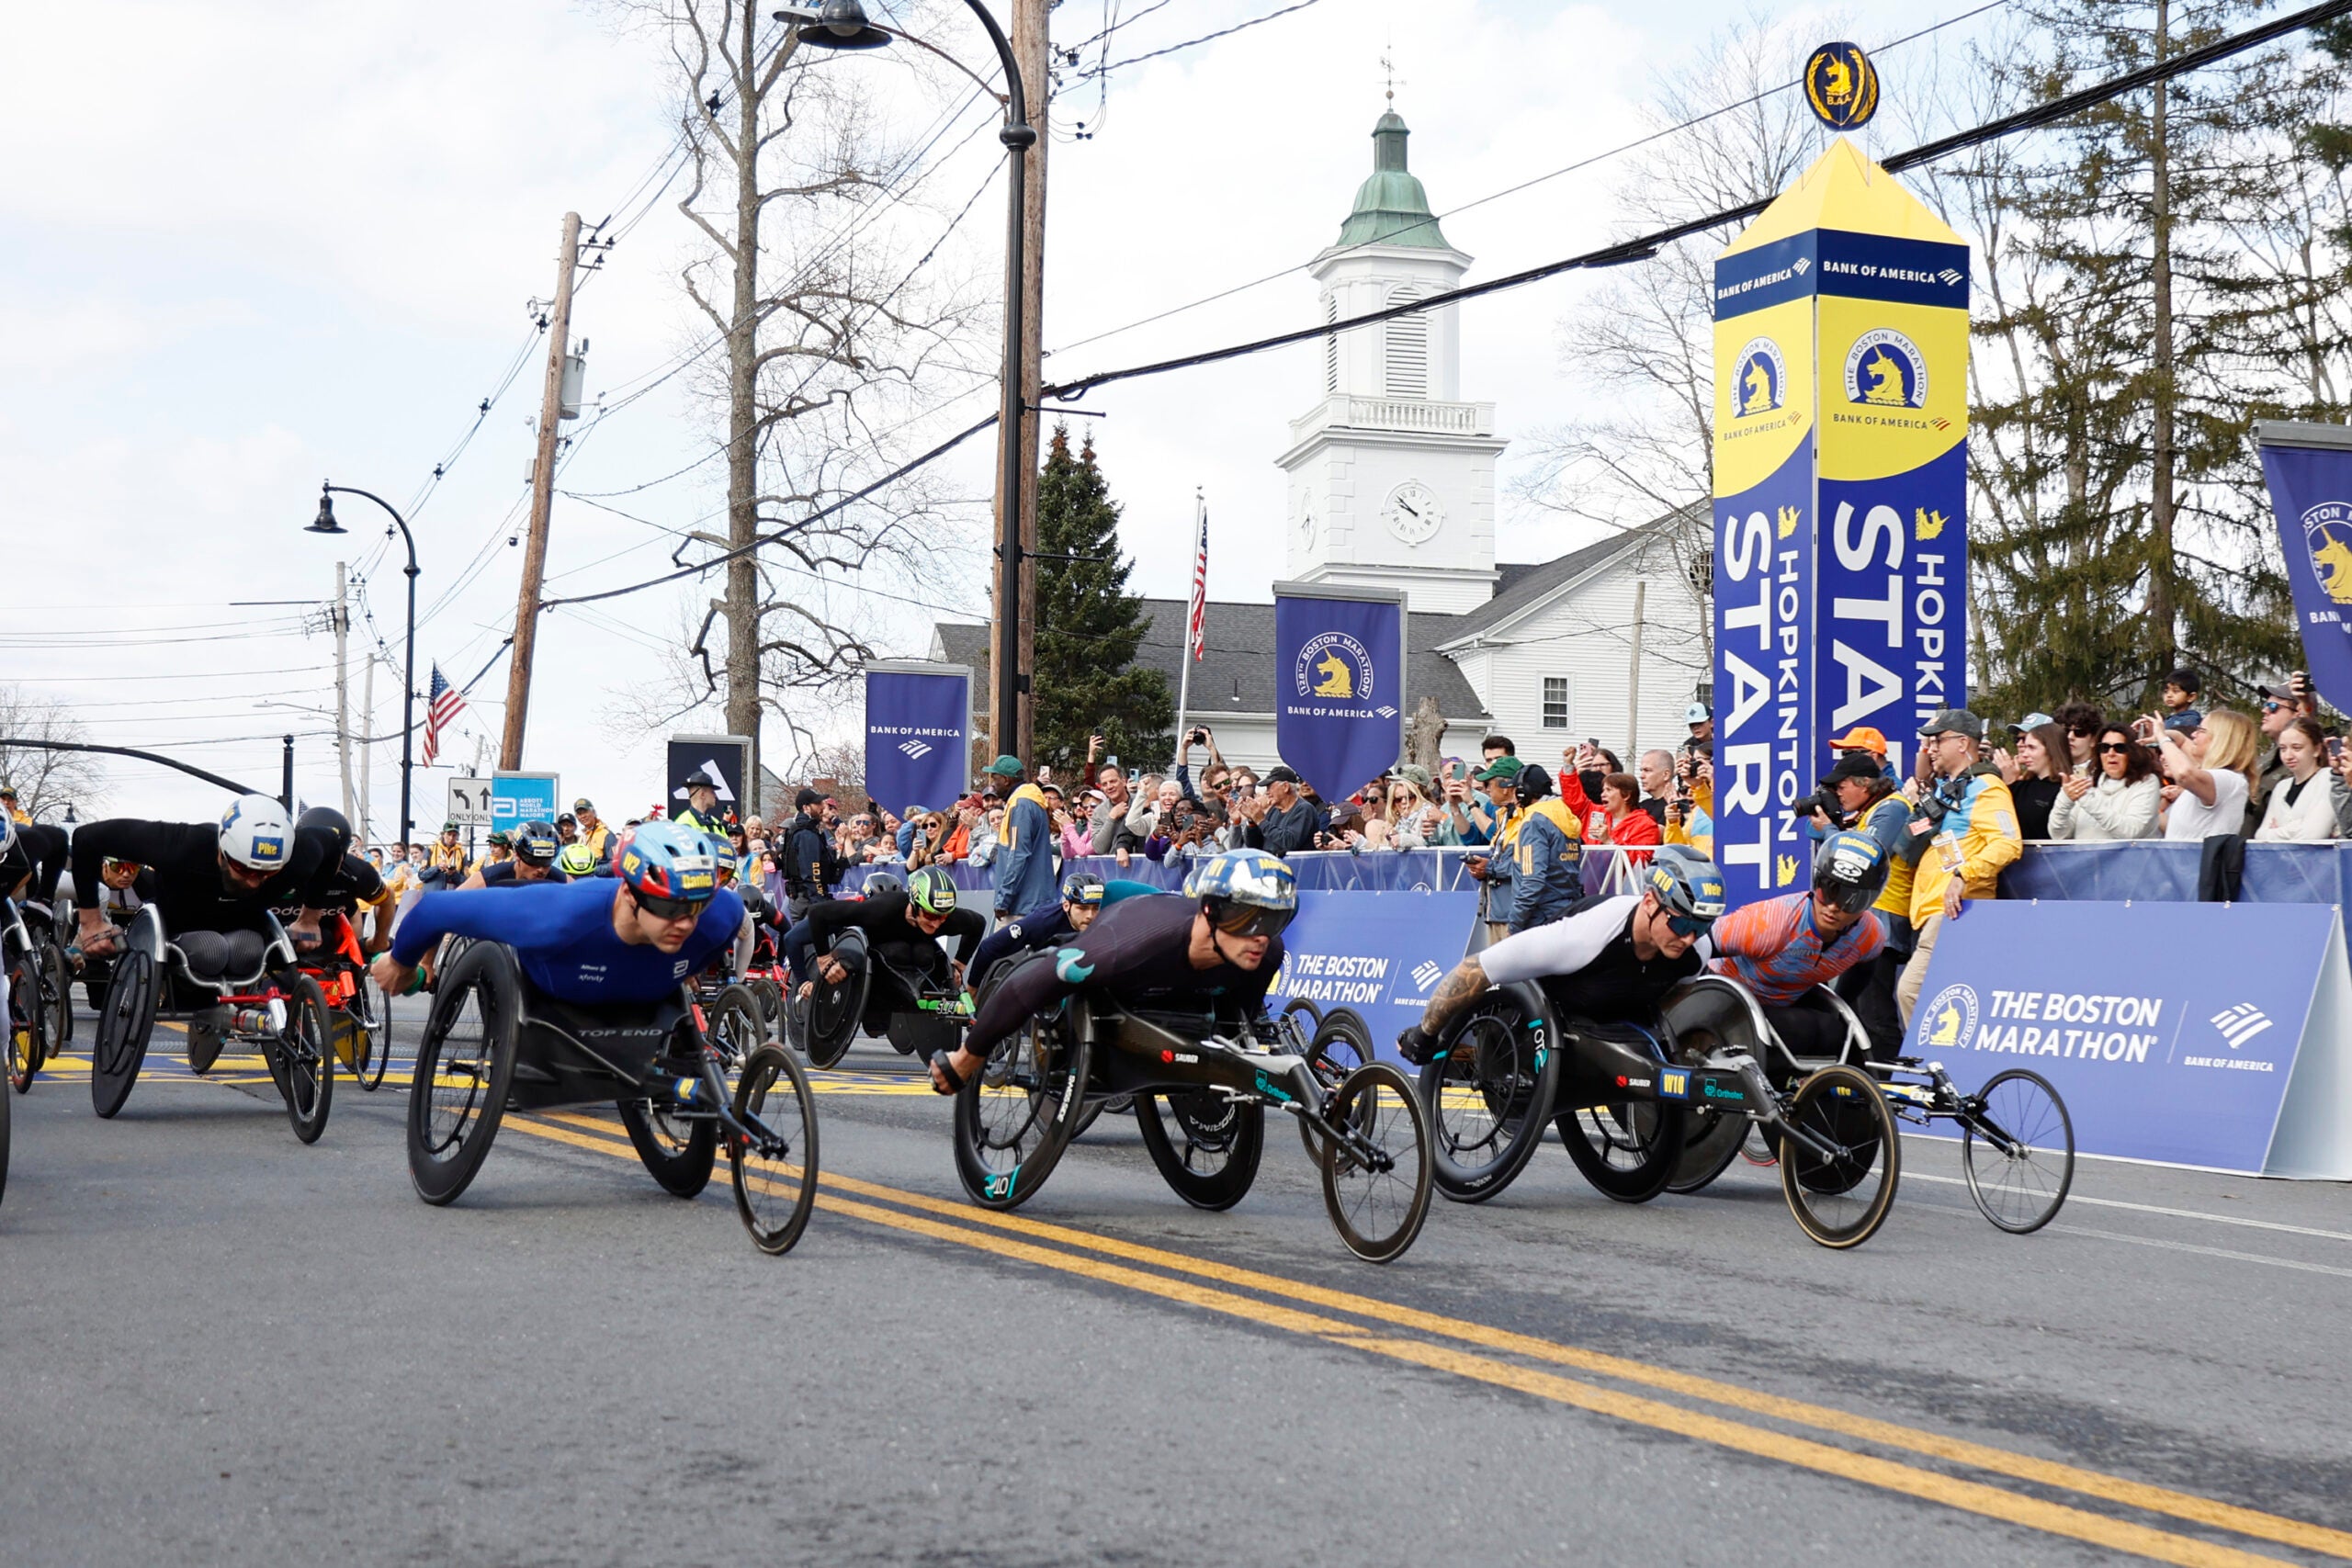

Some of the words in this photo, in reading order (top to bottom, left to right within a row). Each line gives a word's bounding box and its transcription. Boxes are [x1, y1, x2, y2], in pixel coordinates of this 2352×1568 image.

[1823, 260, 1858, 276] BANK
[1860, 265, 1878, 276] OF
[1879, 266, 1937, 284] AMERICA
[1717, 285, 1741, 300] BANK
[1741, 280, 1754, 293] OF
[1753, 268, 1792, 289] AMERICA
[1851, 333, 1889, 360] BOSTON
[1735, 340, 1761, 378] BOSTON
[1762, 341, 1784, 400] MARATHON
[1894, 334, 1925, 400] MARATHON
[1848, 366, 1856, 392] THE
[1724, 428, 1743, 441] BANK
[1743, 425, 1755, 436] OF
[1753, 419, 1787, 435] AMERICA
[1833, 413, 1862, 424] BANK
[1864, 416, 1879, 425] OF
[1880, 417, 1928, 430] AMERICA
[1833, 501, 1905, 785] STA
[1304, 635, 1338, 660] BOSTON
[1343, 637, 1370, 694] MARATHON
[1724, 511, 1772, 889] START
[1778, 551, 1799, 841] HOPKINTON
[1287, 706, 1311, 716] BANK
[1313, 707, 1327, 716] OF
[1328, 709, 1374, 718] AMERICA
[870, 726, 899, 734] BANK
[899, 727, 913, 735] OF
[914, 728, 960, 737] AMERICA
[450, 813, 472, 821] ONLY
[258, 842, 278, 856] Pike
[623, 852, 641, 875] W2
[682, 872, 714, 889] Daniel
[1653, 867, 1674, 893] W10
[1702, 882, 1723, 897] Weir
[1296, 953, 1326, 975] THE
[1324, 955, 1389, 979] BOSTON
[579, 974, 605, 983] xfinity
[1989, 990, 2042, 1021] THE
[2041, 993, 2163, 1027] BOSTON
[579, 1029, 616, 1037] TOP
[1175, 1053, 1199, 1064] SAUBER
[2183, 1056, 2214, 1067] BANK
[2212, 1058, 2229, 1068] OF
[2226, 1059, 2274, 1072] AMERICA
[1628, 1077, 1651, 1088] SAUBER
[1663, 1073, 1685, 1095] W10
[1716, 1089, 1744, 1100] Orthotec
